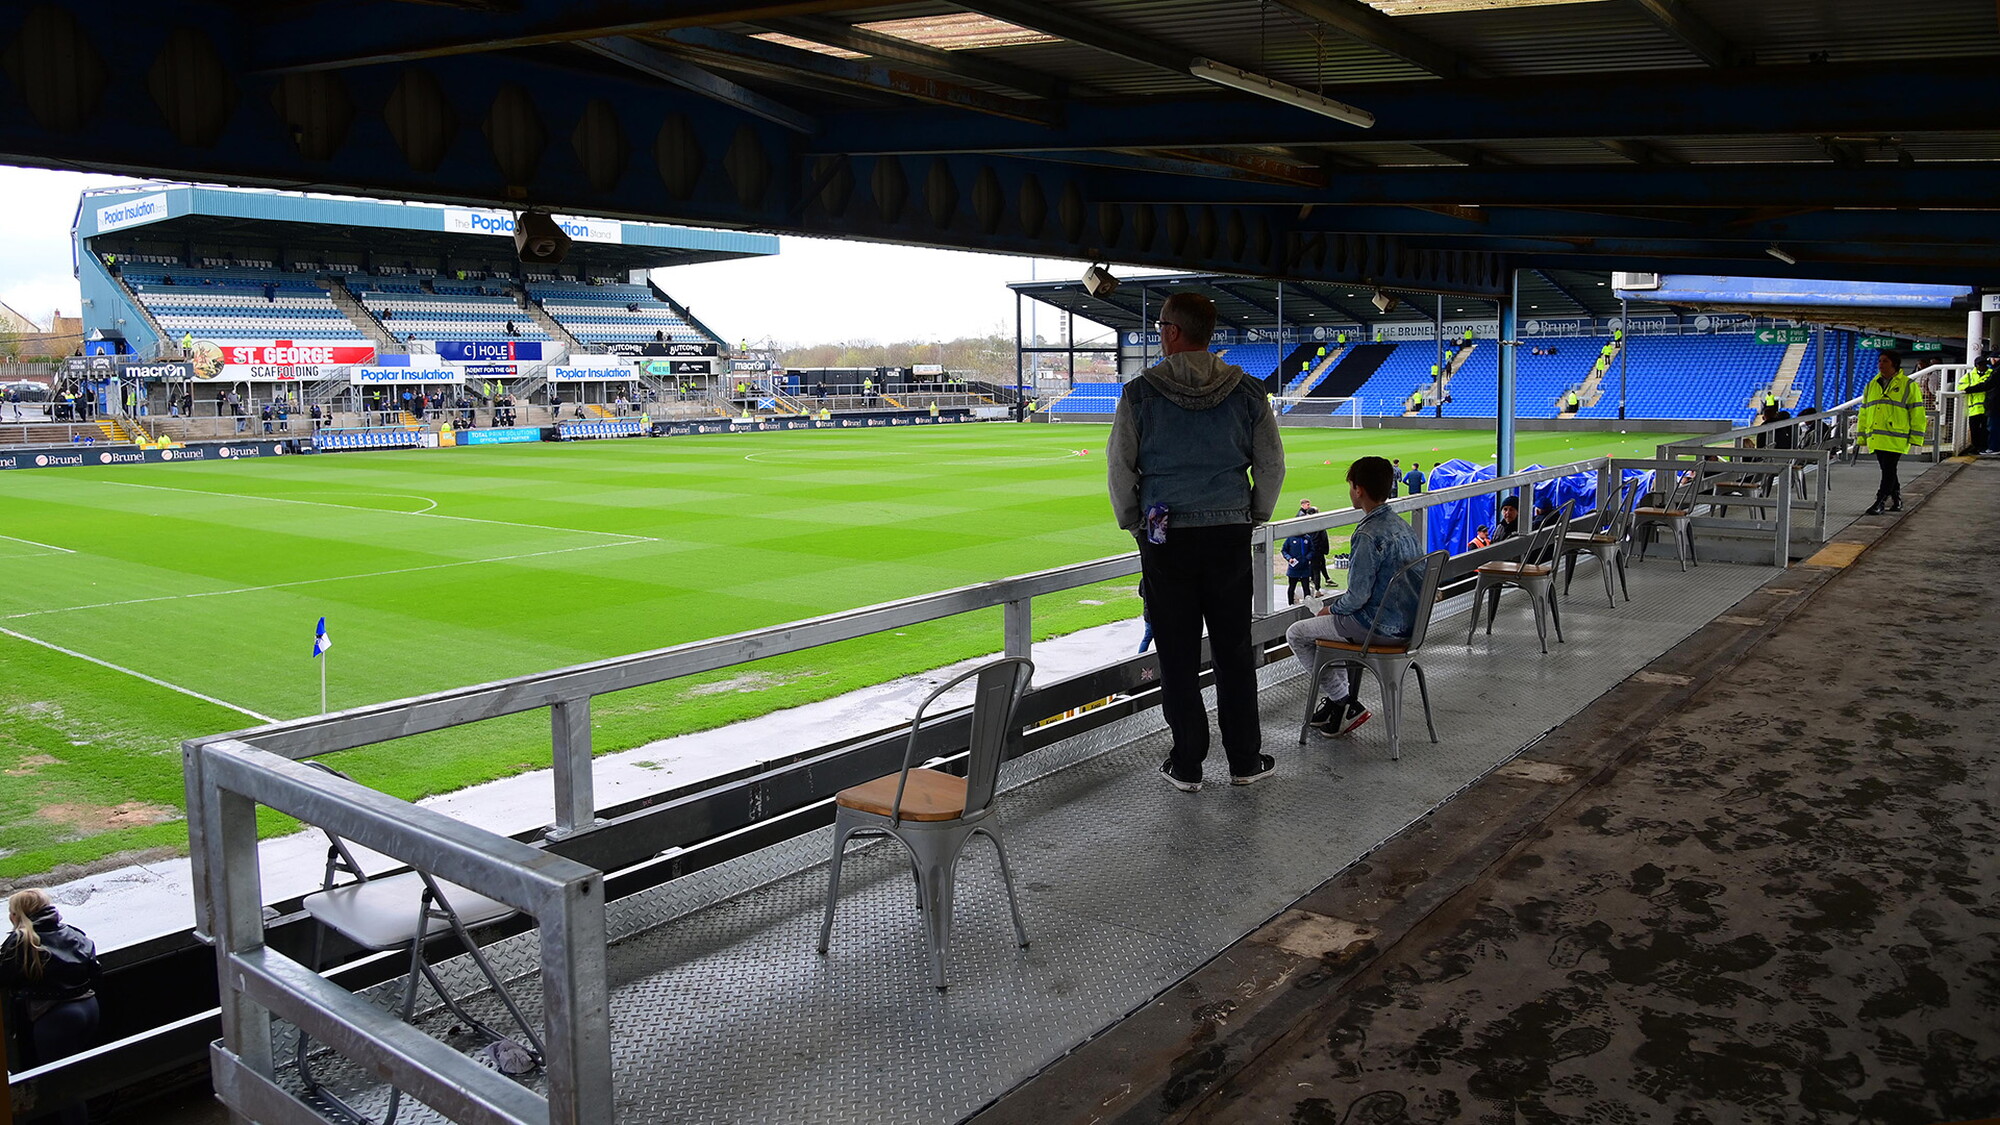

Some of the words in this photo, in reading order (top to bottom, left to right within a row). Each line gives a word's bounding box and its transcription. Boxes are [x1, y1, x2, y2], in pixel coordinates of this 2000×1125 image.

[105, 208, 124, 226] Poplar
[125, 202, 155, 220] Insulation
[455, 219, 469, 229] The
[471, 214, 515, 233] Popla
[590, 228, 612, 239] Stand
[1326, 326, 1360, 338] Brunel
[1398, 326, 1435, 336] BRUNEL
[1540, 320, 1580, 332] Brunel
[670, 343, 703, 355] BUTCOMBE
[1882, 339, 1894, 347] EXIT
[233, 347, 260, 364] ST.
[263, 347, 334, 364] GEORGE
[479, 345, 508, 356] HOLE
[125, 364, 186, 377] macron
[734, 361, 766, 370] macron
[251, 366, 319, 378] SCAFFOLDING
[361, 369, 399, 382] Poplar
[401, 369, 454, 380] Insulation
[555, 368, 587, 380] Poplar
[588, 367, 631, 378] Insulation
[112, 452, 145, 462] Brunel
[173, 449, 203, 459] Brunel
[230, 446, 259, 456] Brunel
[0, 456, 16, 466] nel
[48, 454, 83, 465] Brunel
